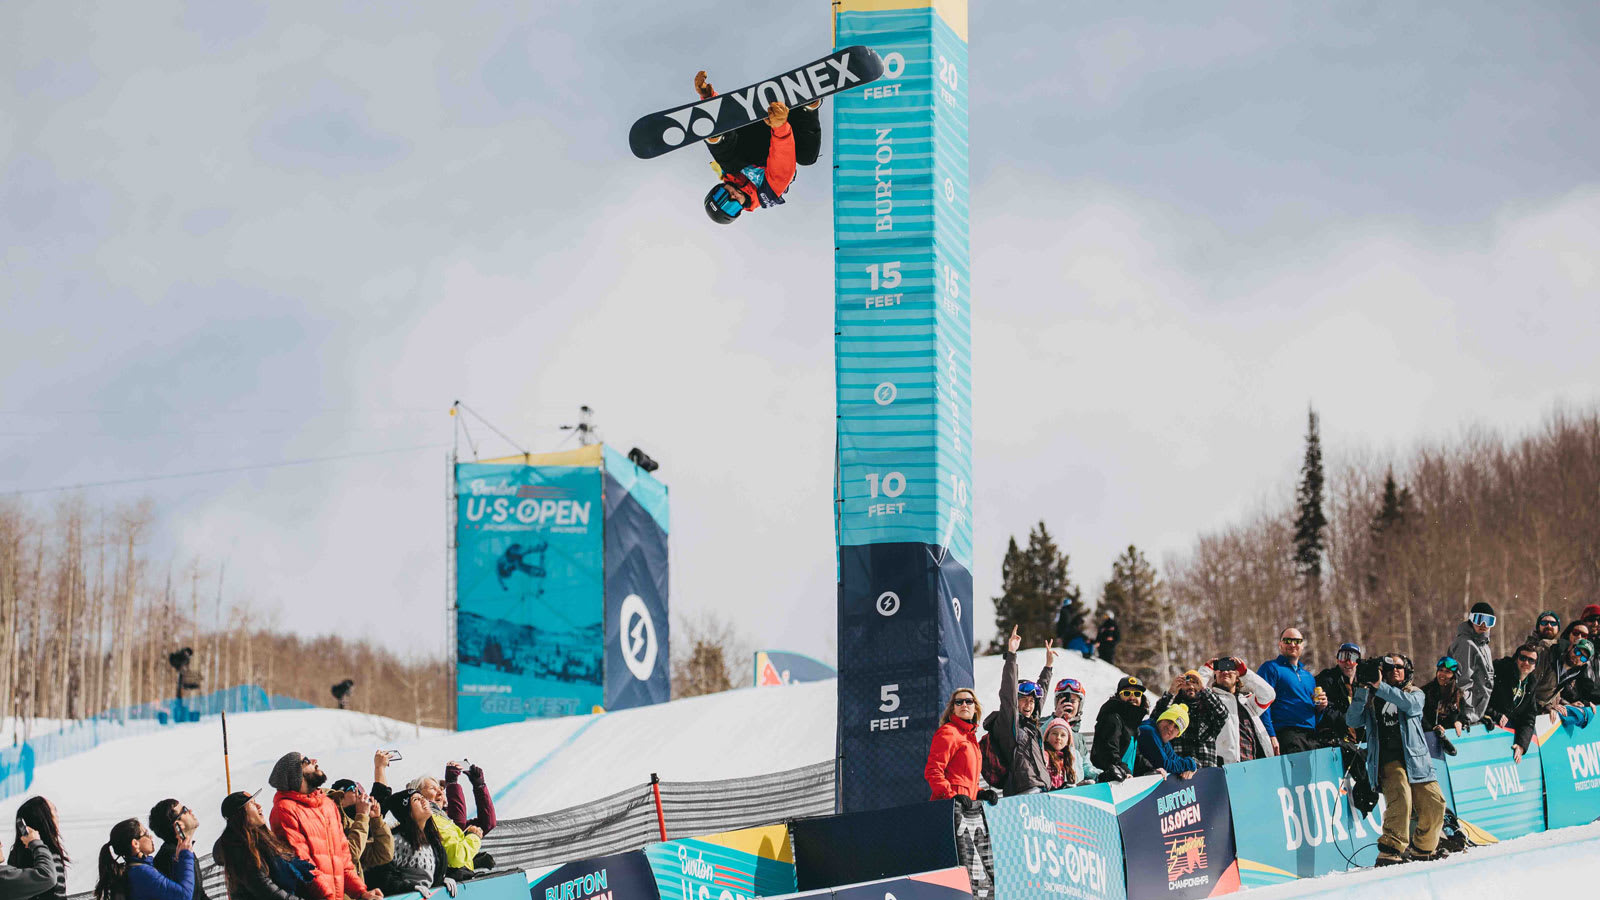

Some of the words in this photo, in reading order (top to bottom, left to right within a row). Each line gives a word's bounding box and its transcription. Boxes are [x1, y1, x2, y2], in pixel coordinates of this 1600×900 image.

[731, 52, 861, 120] YONEX
[939, 55, 957, 91] 20
[864, 84, 901, 100] FEET
[941, 87, 956, 108] FEET
[876, 127, 893, 232] BURTON
[865, 261, 902, 291] 15
[943, 265, 959, 299] 15
[865, 293, 903, 309] FEET
[943, 296, 959, 317] FEET
[865, 471, 906, 499] 10
[951, 474, 967, 508] 10
[868, 503, 905, 517] FEET
[878, 684, 901, 713] 5
[870, 716, 909, 732] FEET
[1495, 764, 1523, 795] VAIL
[1157, 785, 1197, 815] BURTON
[1278, 776, 1387, 851] BURTO
[1019, 803, 1057, 835] Burton
[678, 845, 713, 881] Burton
[545, 869, 609, 900] BURTON
